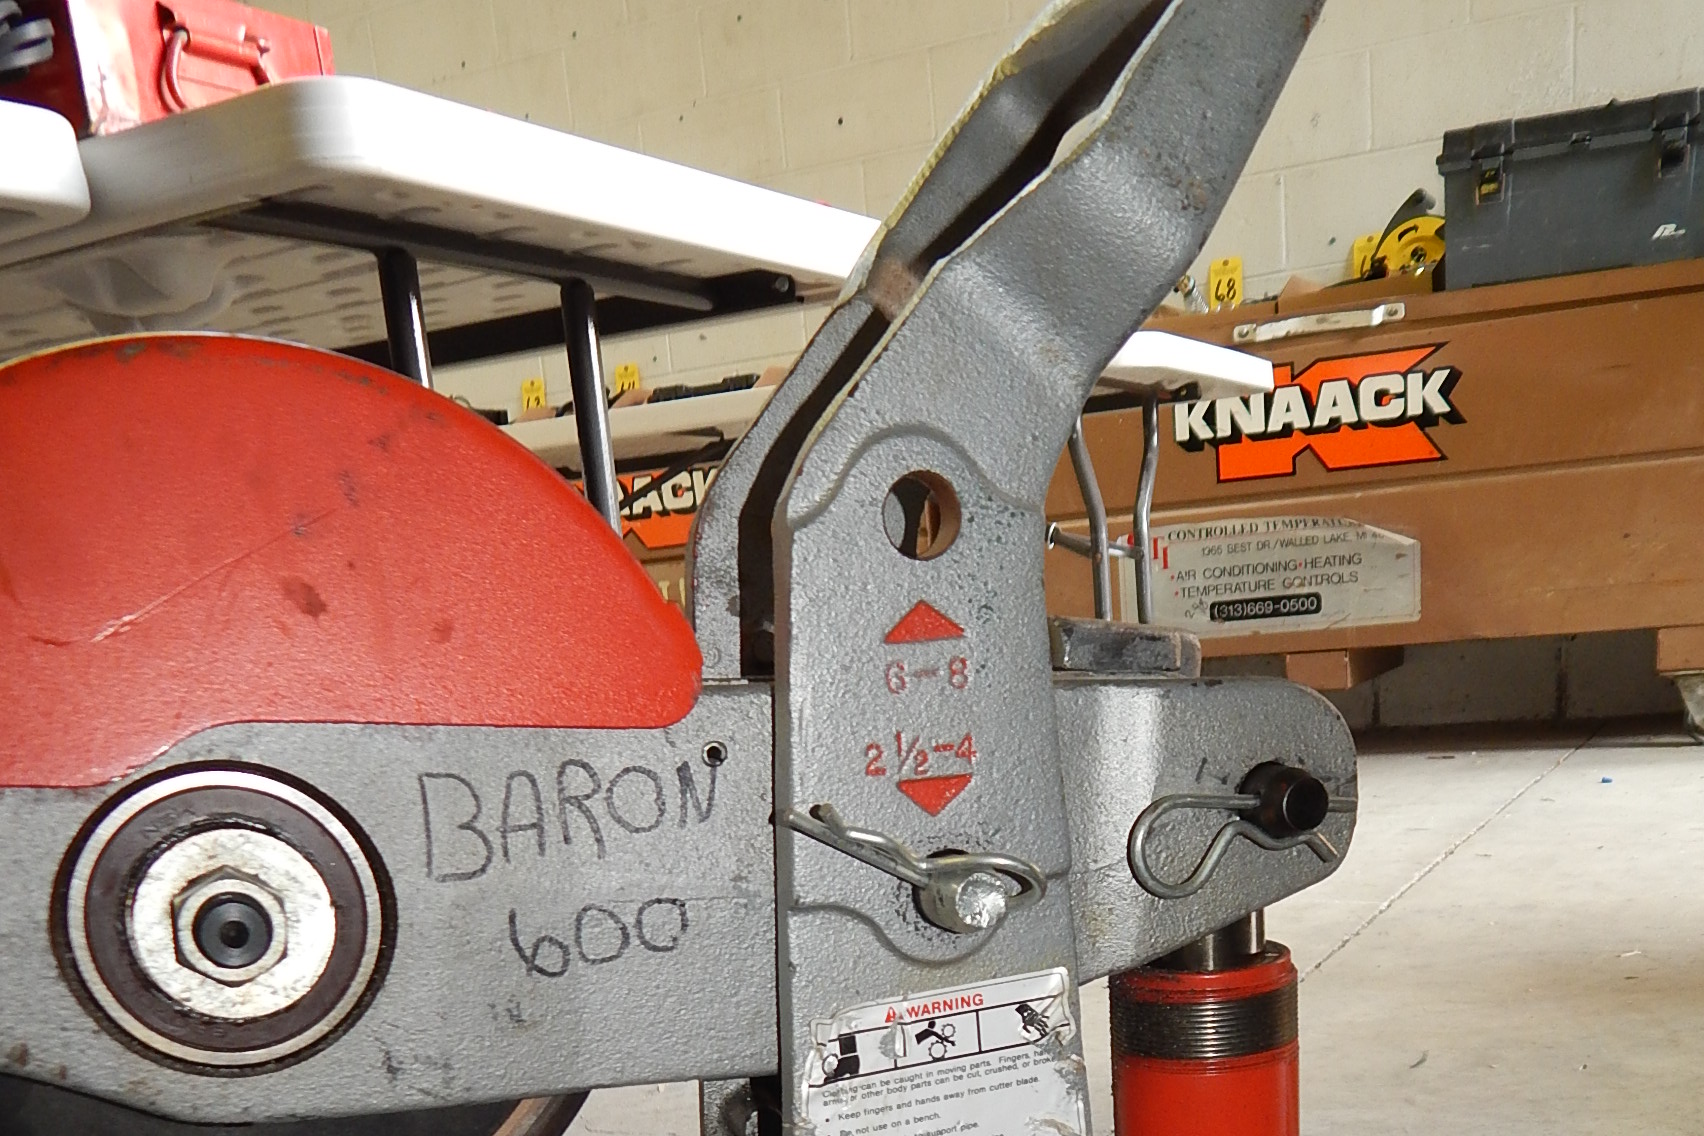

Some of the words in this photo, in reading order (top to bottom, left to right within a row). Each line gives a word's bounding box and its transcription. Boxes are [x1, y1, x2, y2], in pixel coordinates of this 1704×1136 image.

[1215, 278, 1237, 302] 68
[1174, 367, 1453, 444] KNAACK
[1168, 522, 1259, 541] CONTROLLED
[1227, 542, 1253, 554] BEST
[1176, 569, 1197, 582] AIR
[1181, 579, 1276, 598] TEMPERATURE
[1282, 571, 1359, 589] CONTROLS
[1214, 597, 1318, 619] (313)669-0500
[418, 758, 718, 883] BARON
[507, 897, 690, 978] 600
[906, 993, 984, 1018] WARNING
[861, 1082, 877, 1091] can
[880, 1078, 890, 1086] be
[894, 1072, 923, 1085] caught
[926, 1070, 934, 1078] in
[937, 1064, 966, 1076] moving
[861, 1088, 883, 1099] other
[886, 1083, 908, 1095] body
[911, 1080, 931, 1091] parts
[935, 1077, 950, 1086] can
[953, 1074, 964, 1083] be
[1022, 1060, 1031, 1068] or
[1033, 1056, 1056, 1067] broke
[838, 1110, 861, 1121] Keep
[864, 1104, 894, 1117] fingers
[896, 1100, 912, 1109] and
[915, 1095, 941, 1106] hands
[943, 1091, 965, 1102] away
[967, 1087, 987, 1096] from
[989, 1081, 1013, 1092] cutter
[856, 1126, 870, 1134] not
[872, 1123, 888, 1132] use
[891, 1120, 902, 1128] on
